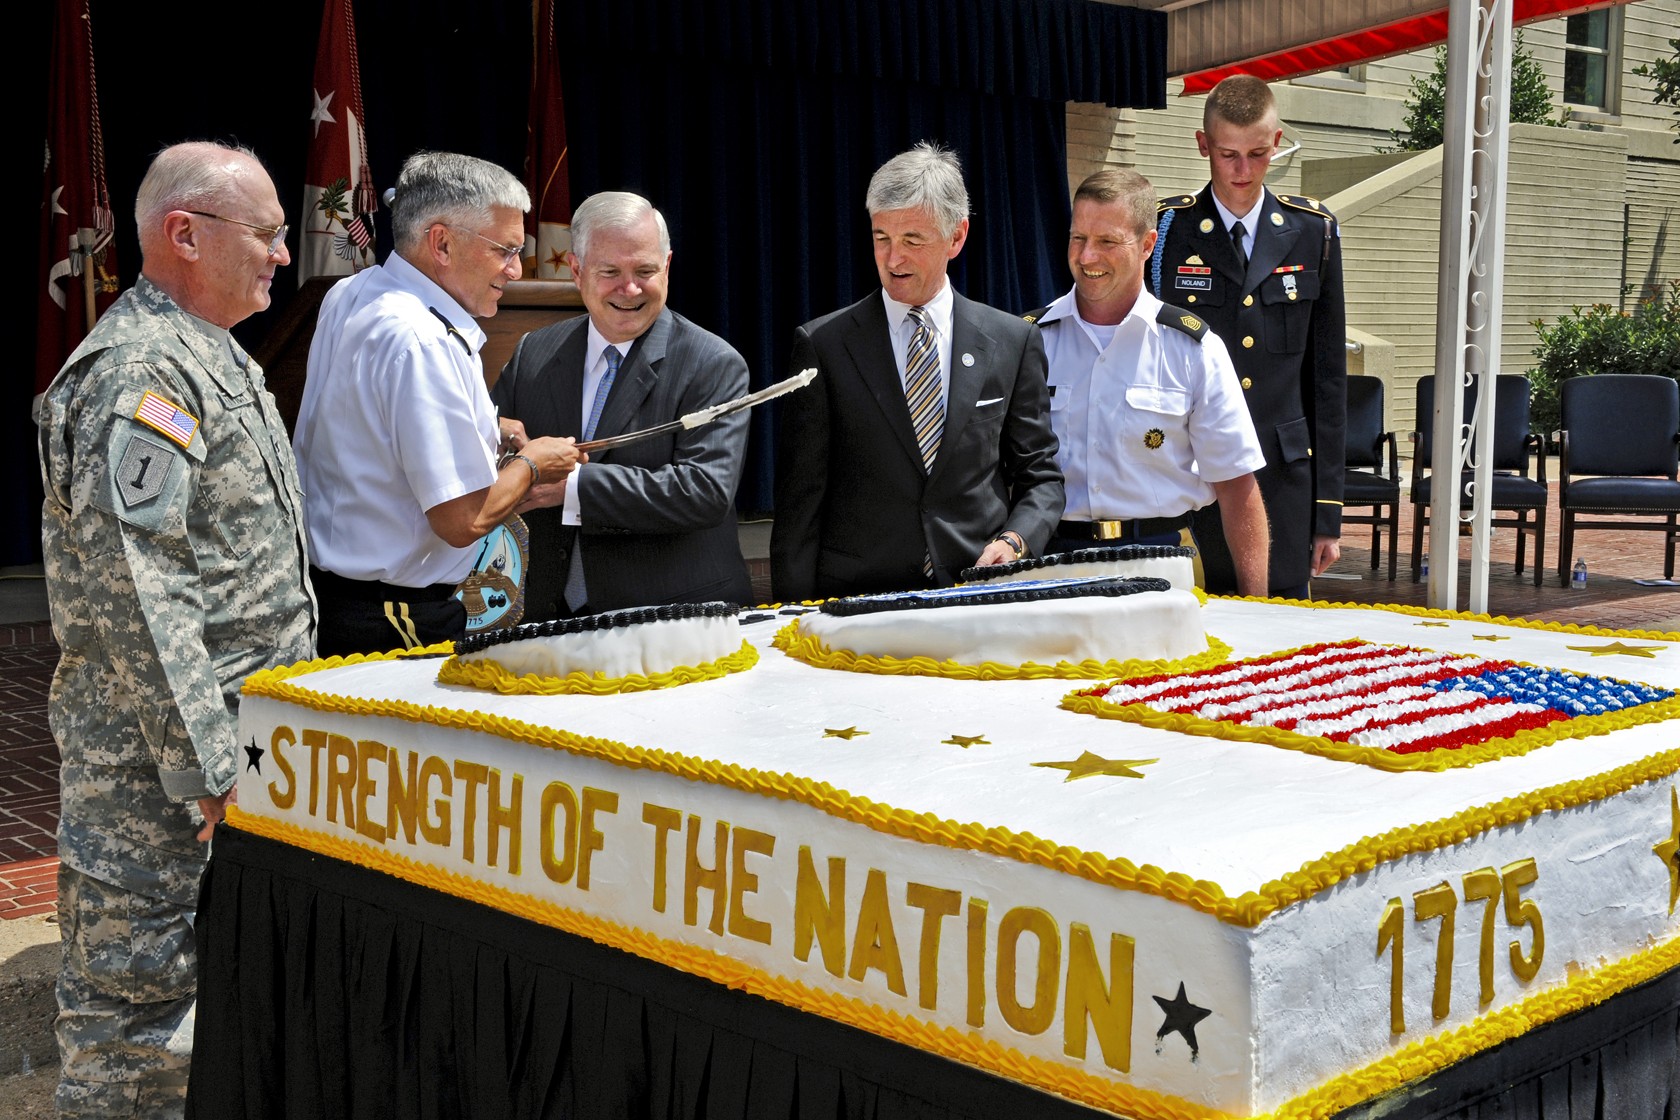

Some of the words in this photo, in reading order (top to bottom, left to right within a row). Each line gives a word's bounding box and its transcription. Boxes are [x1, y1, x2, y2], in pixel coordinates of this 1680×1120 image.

[131, 455, 152, 490] 1
[467, 617, 484, 626] 775
[267, 725, 524, 876] STRENGTH
[540, 780, 620, 891] OF
[641, 802, 776, 945] THE
[793, 845, 1136, 1073] NATION
[1377, 857, 1545, 1034] 1775
